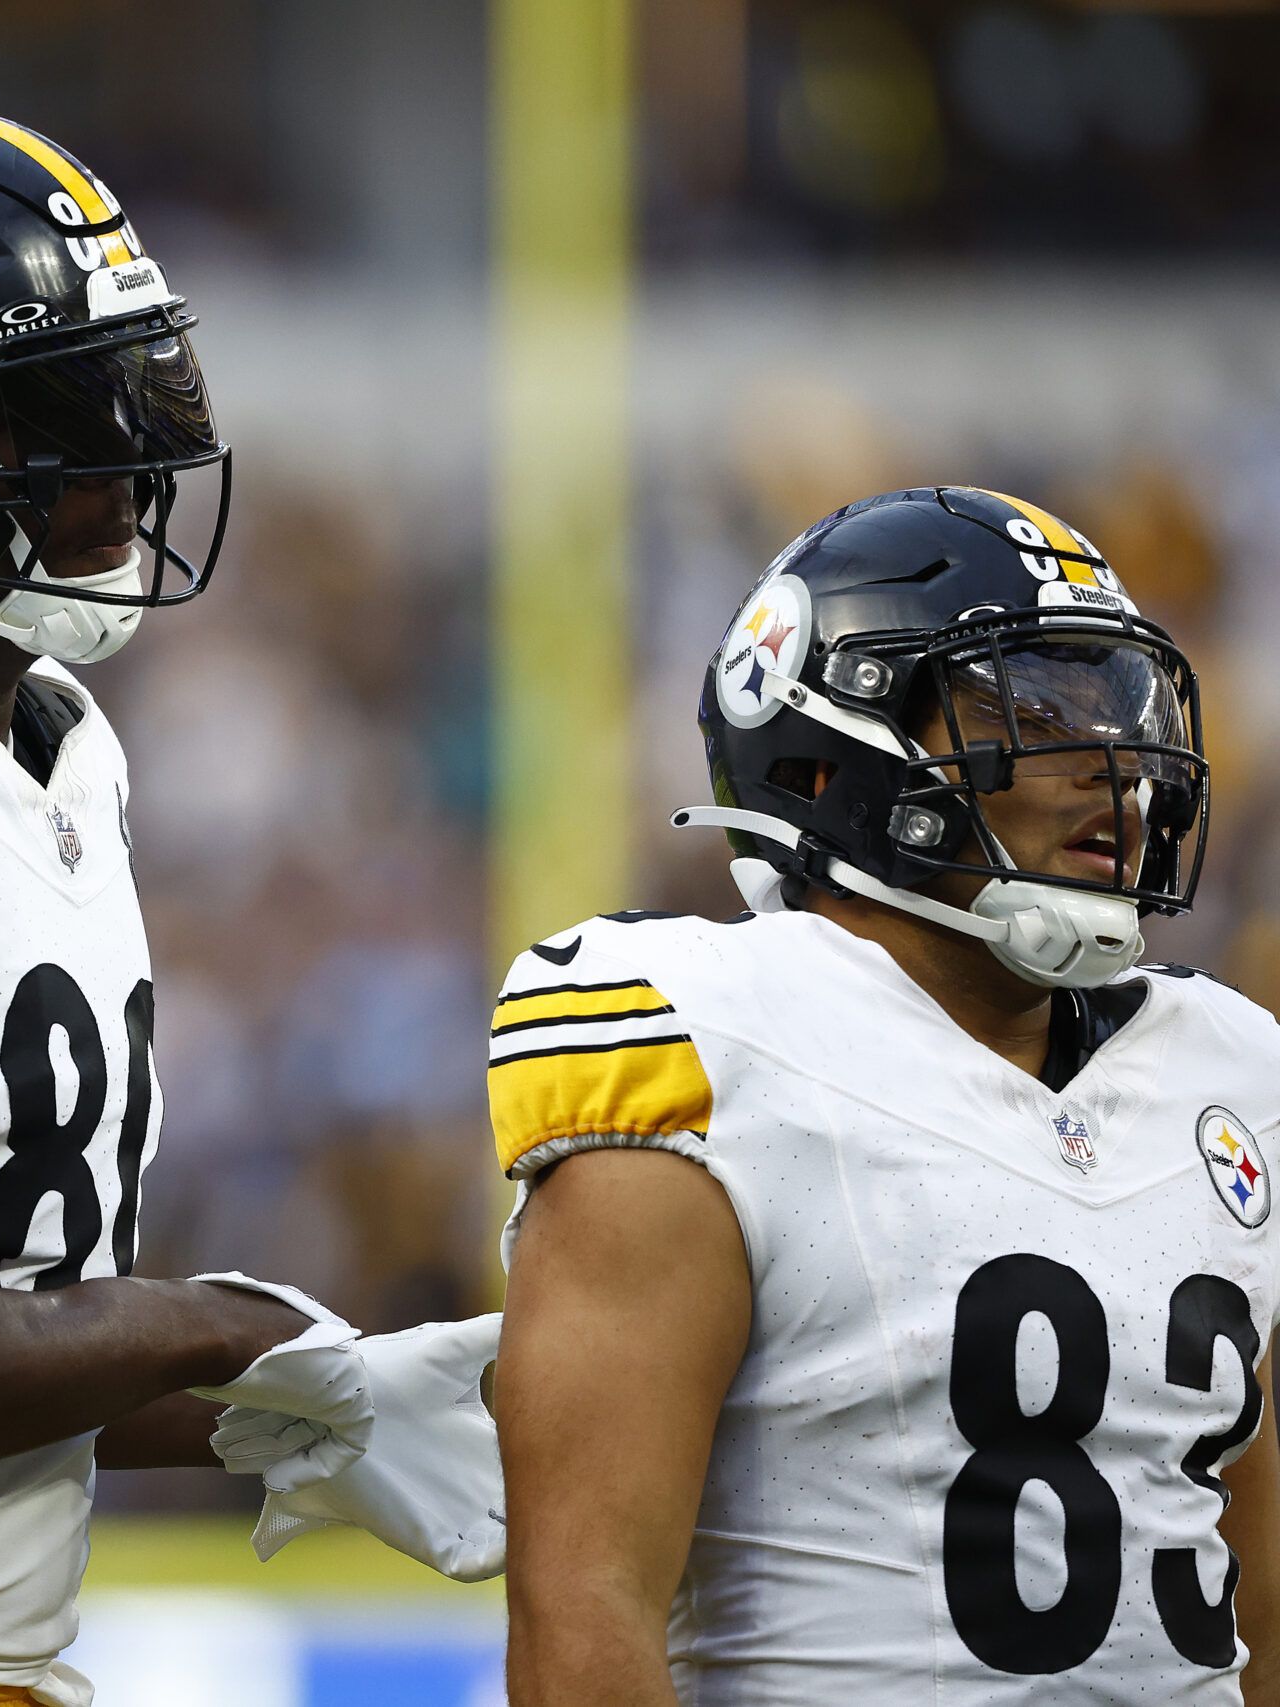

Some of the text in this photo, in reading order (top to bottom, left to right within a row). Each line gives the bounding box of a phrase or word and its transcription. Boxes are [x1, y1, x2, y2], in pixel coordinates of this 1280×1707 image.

[112, 269, 156, 292] Steelers
[725, 645, 752, 675] Steelers
[61, 834, 80, 859] NFL
[1062, 1137, 1093, 1160] NFL
[943, 1253, 1263, 1675] 83
